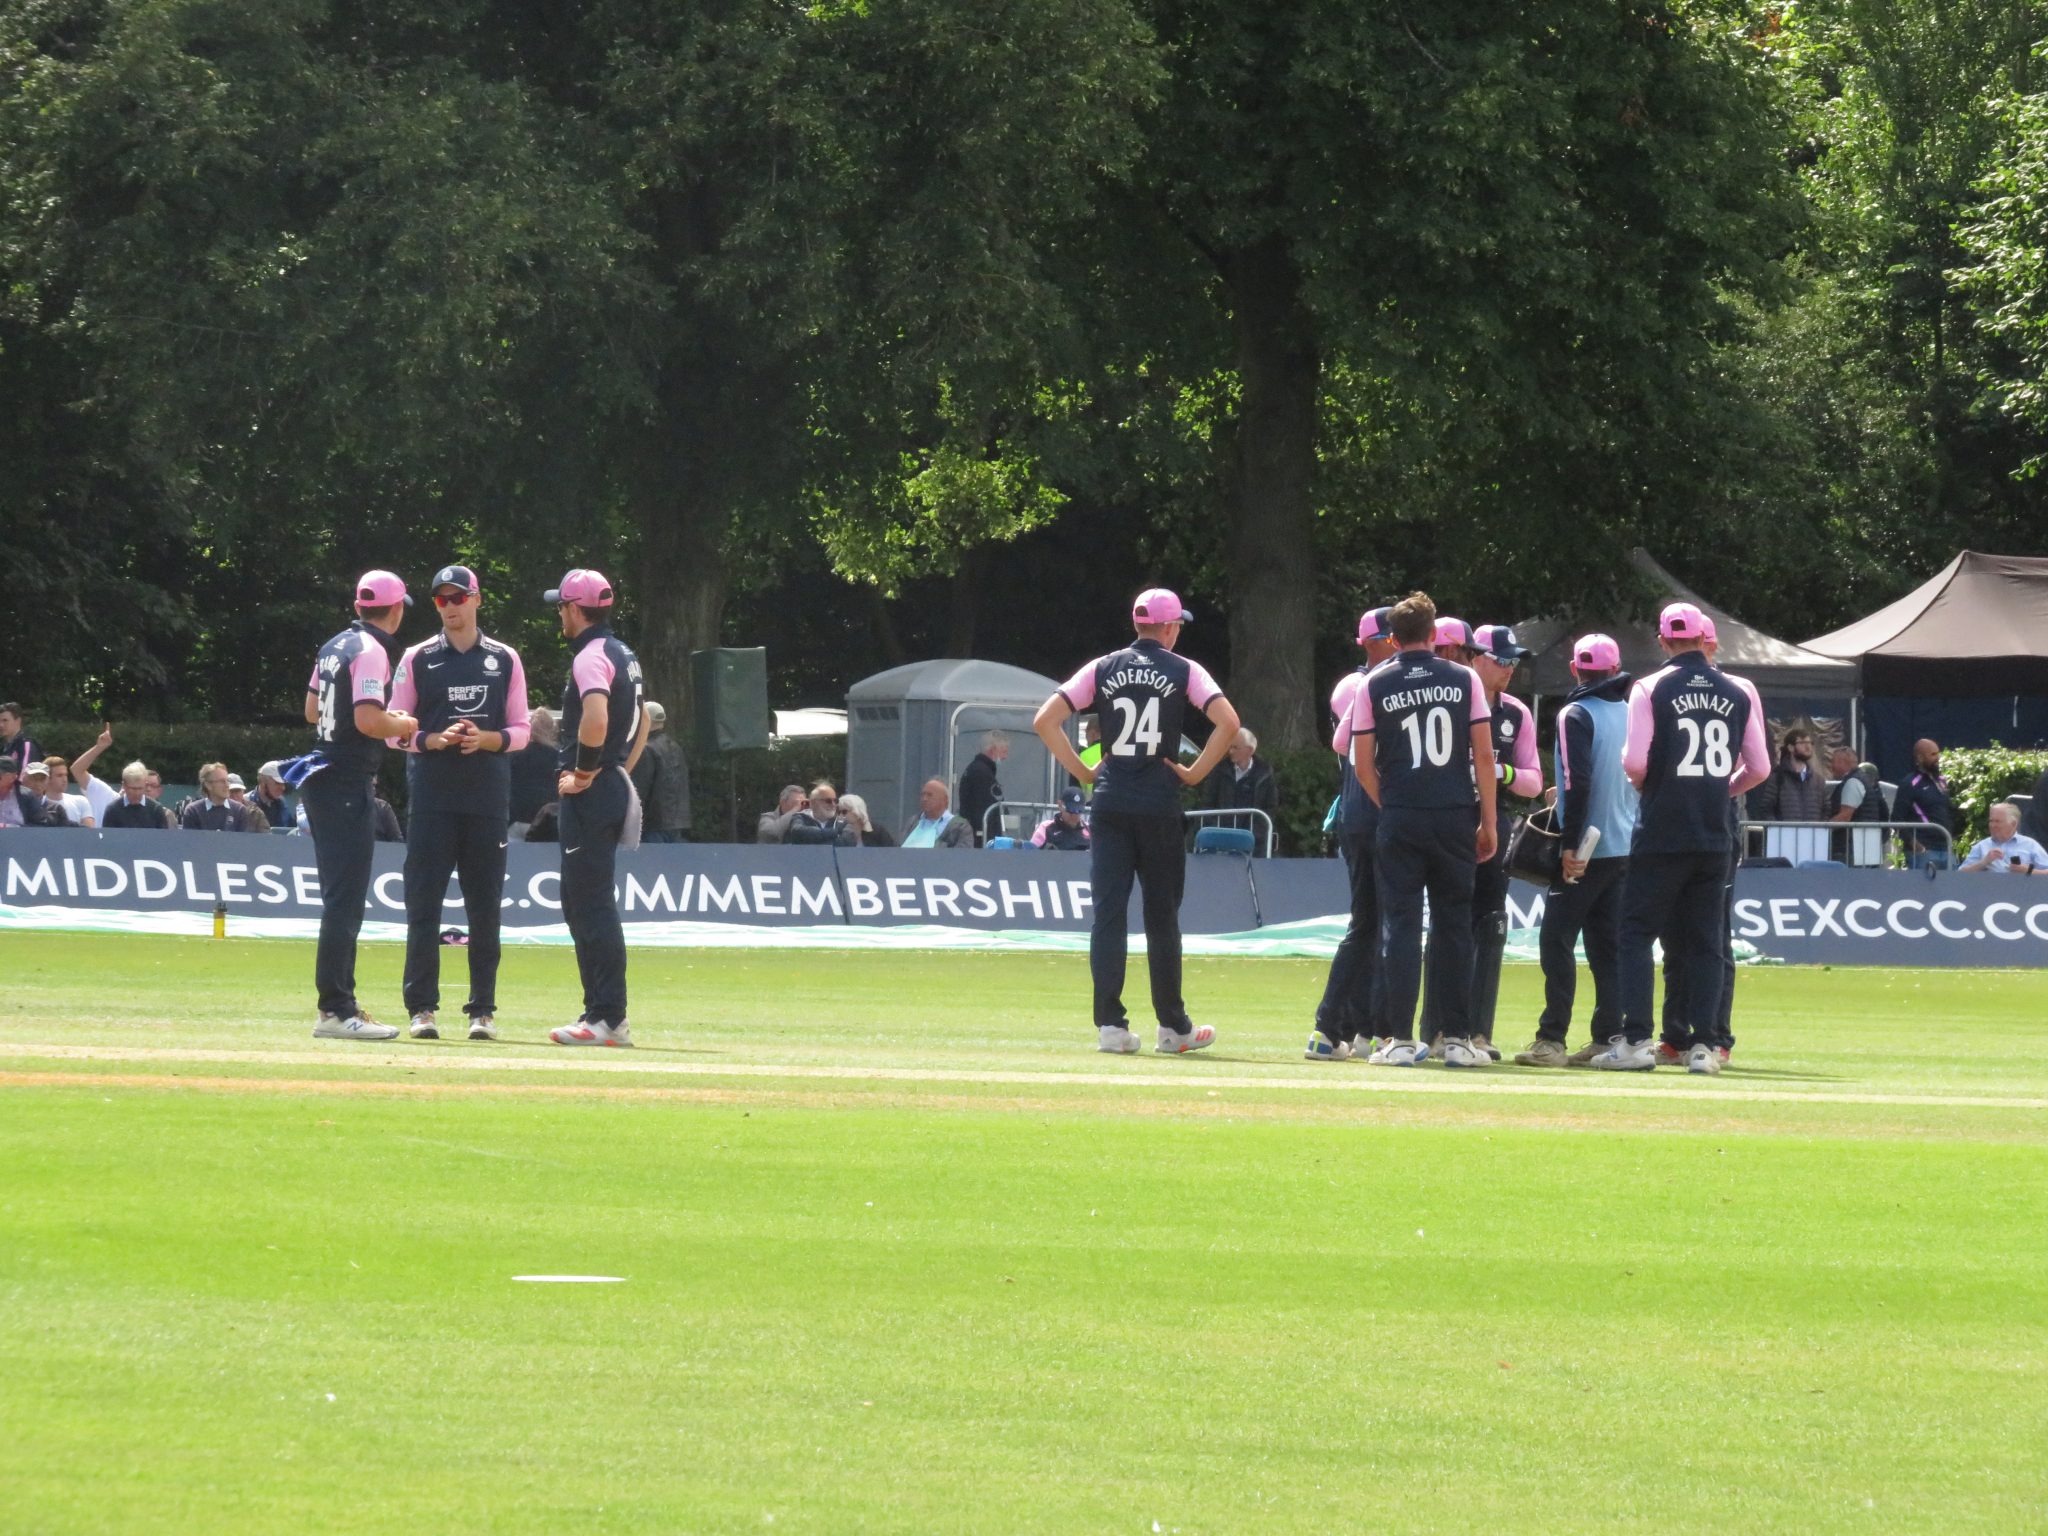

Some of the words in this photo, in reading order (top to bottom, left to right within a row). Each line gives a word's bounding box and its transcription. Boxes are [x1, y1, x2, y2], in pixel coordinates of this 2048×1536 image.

[448, 685, 489, 695] PERFECT
[448, 692, 476, 702] SMILE
[1101, 668, 1177, 699] ANDERSSON
[1382, 686, 1463, 713] GREATWOOD
[1671, 693, 1735, 717] ESKINAZI
[1111, 697, 1162, 757] 24
[1401, 706, 1453, 770] 10
[1676, 718, 1733, 777] 28
